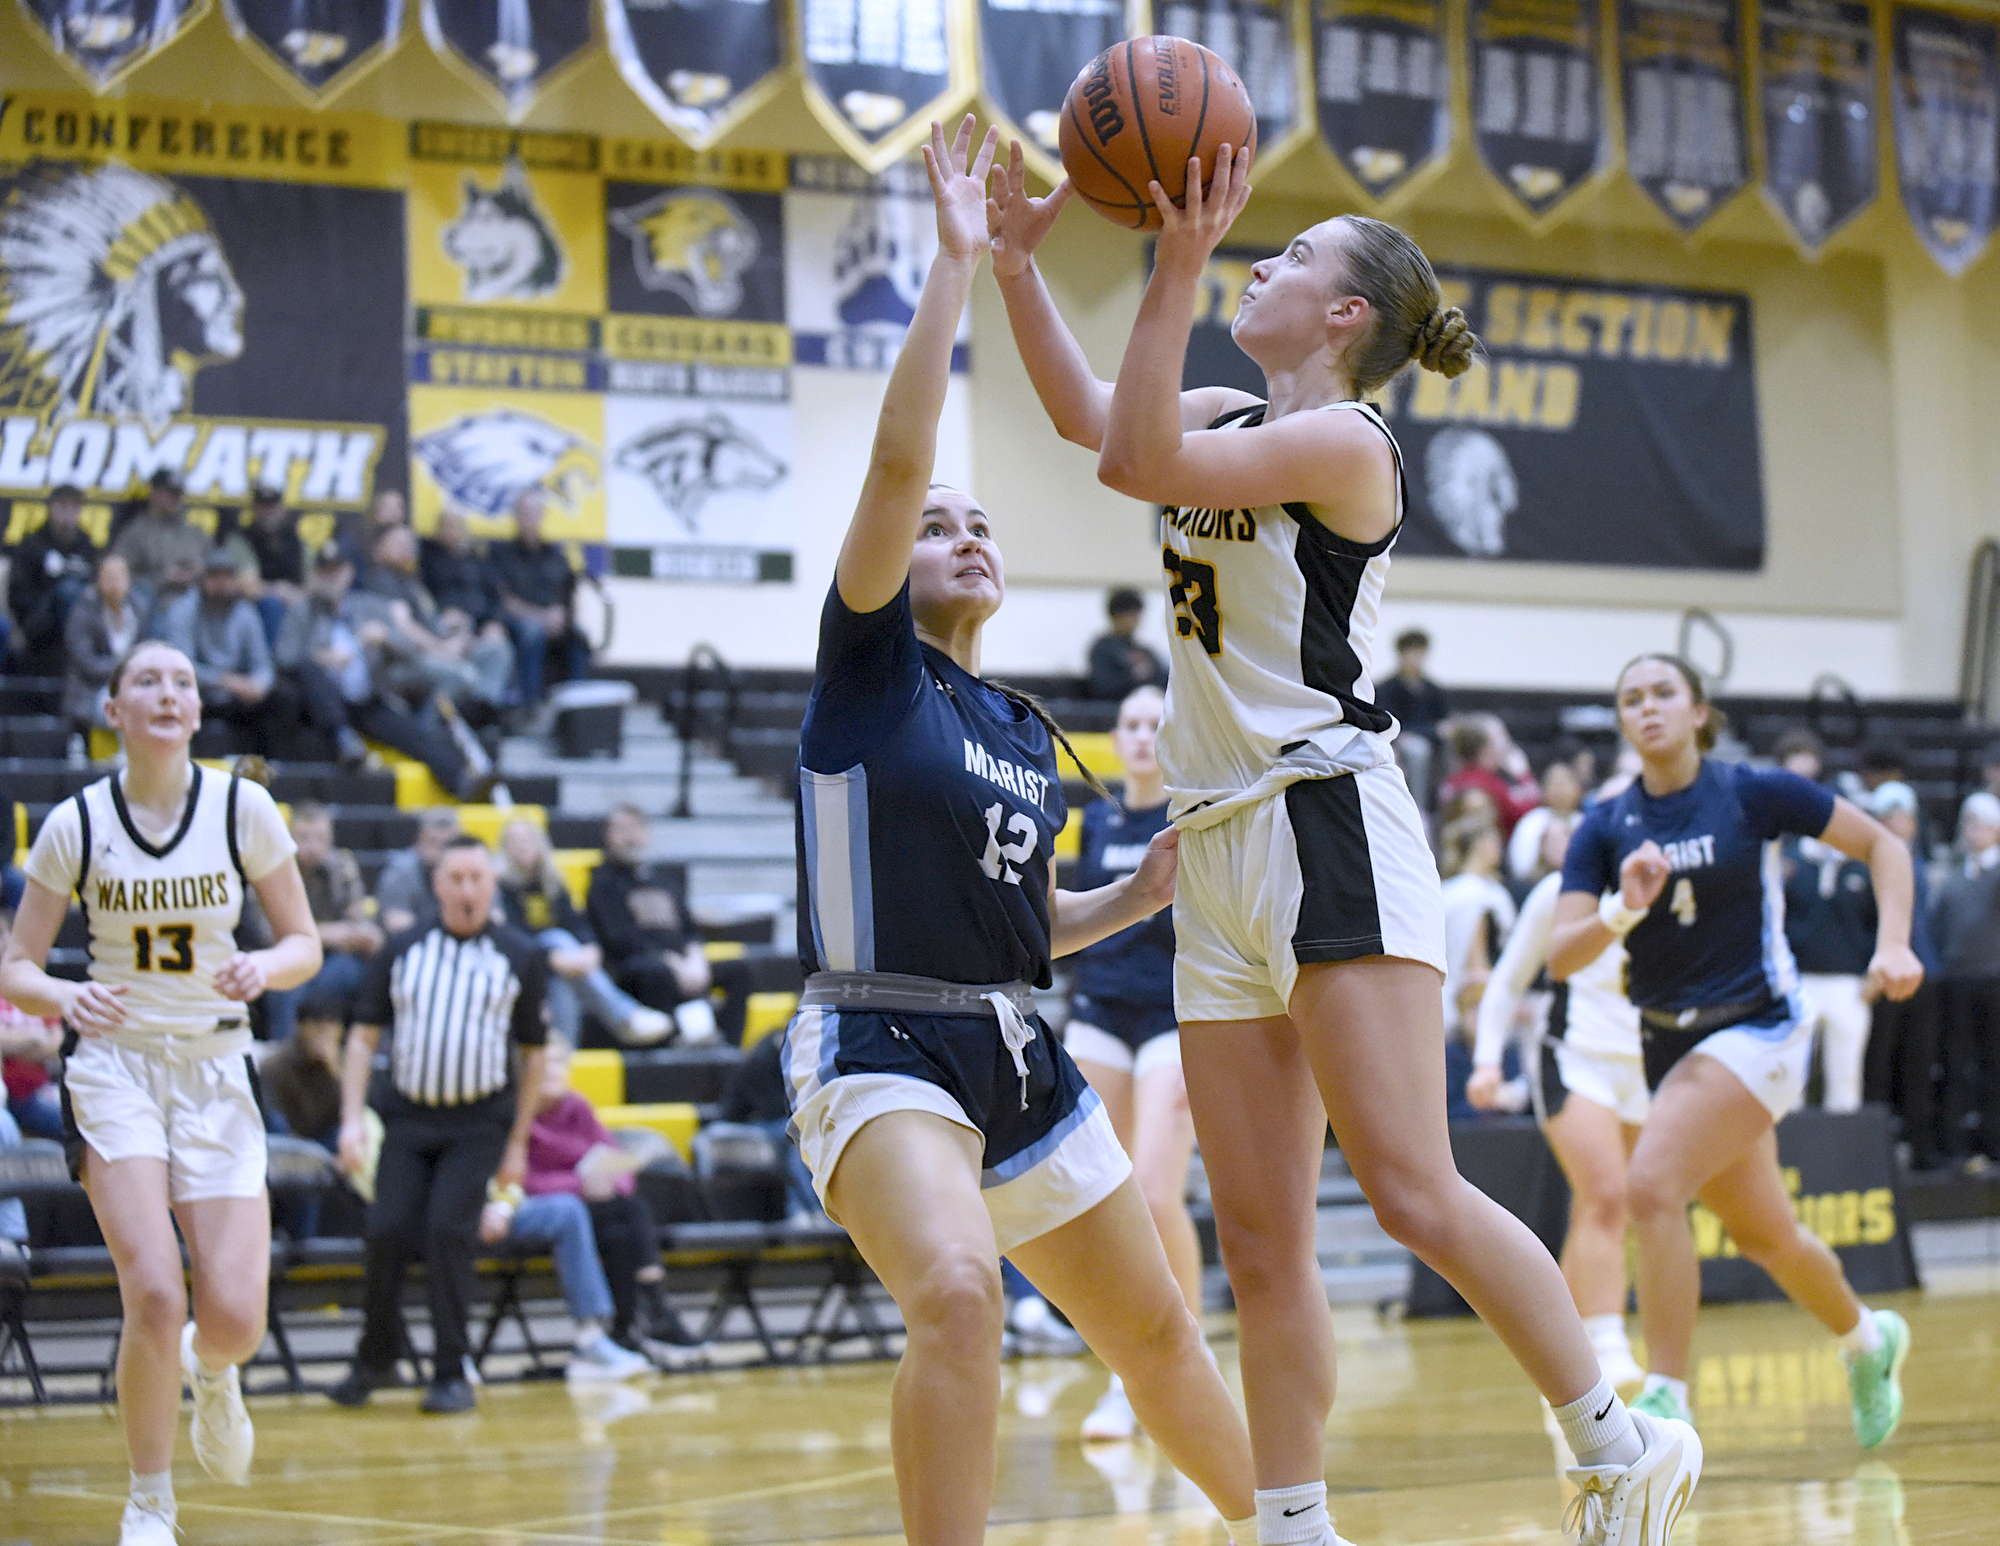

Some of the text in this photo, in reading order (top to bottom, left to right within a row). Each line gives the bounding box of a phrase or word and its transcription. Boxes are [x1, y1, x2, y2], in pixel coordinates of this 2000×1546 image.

[24, 108, 350, 168] CONFERENCE
[1485, 284, 1738, 367] SECTION
[1411, 359, 1579, 429] BAND
[963, 737, 1049, 814] MARIST
[977, 800, 1039, 887] 12
[1661, 834, 1717, 871] RIST
[96, 871, 229, 912] WARRIORS
[1668, 877, 1698, 927] 4
[131, 921, 197, 974] 13
